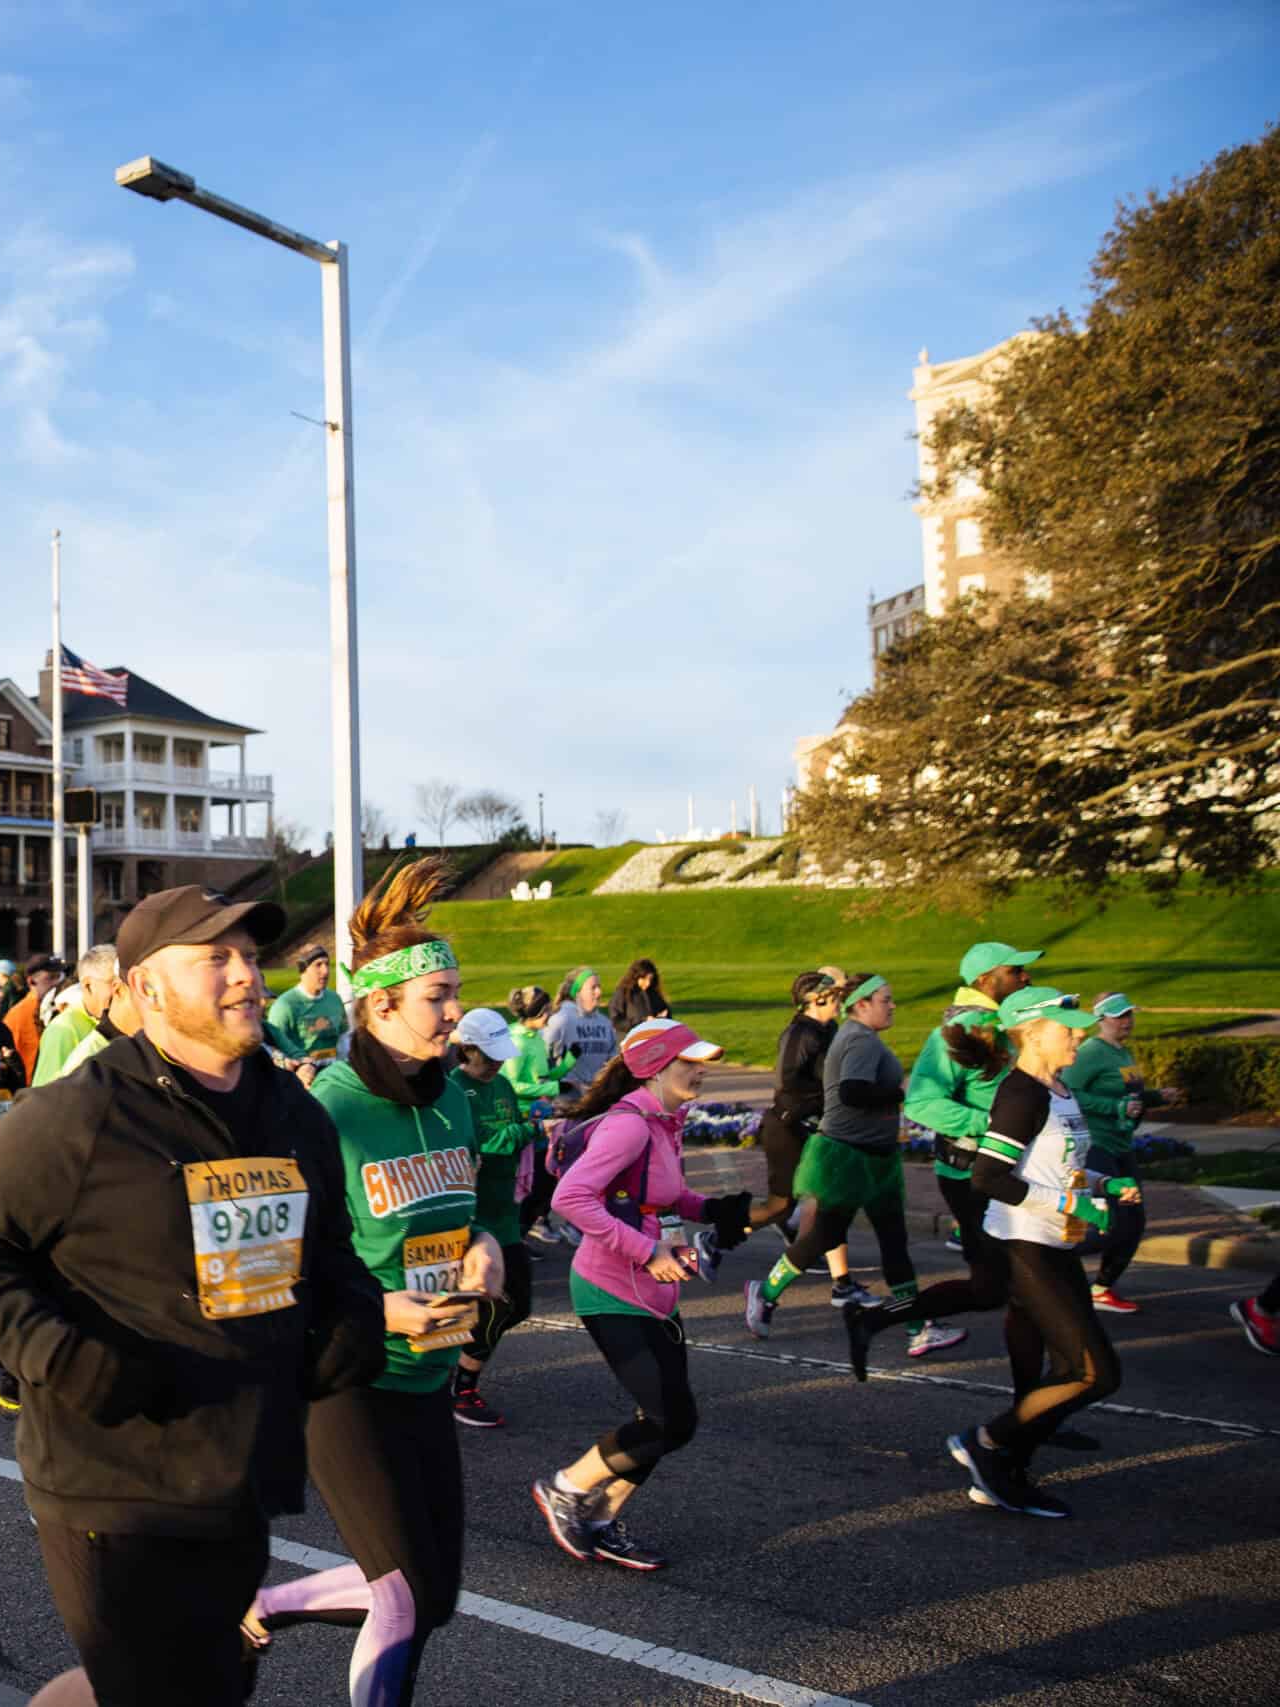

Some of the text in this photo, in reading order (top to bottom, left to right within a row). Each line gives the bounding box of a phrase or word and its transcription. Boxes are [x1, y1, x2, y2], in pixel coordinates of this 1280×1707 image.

[204, 1170, 291, 1197] THOMAS
[213, 1202, 289, 1243] 9208
[407, 1240, 466, 1264] SAMANT
